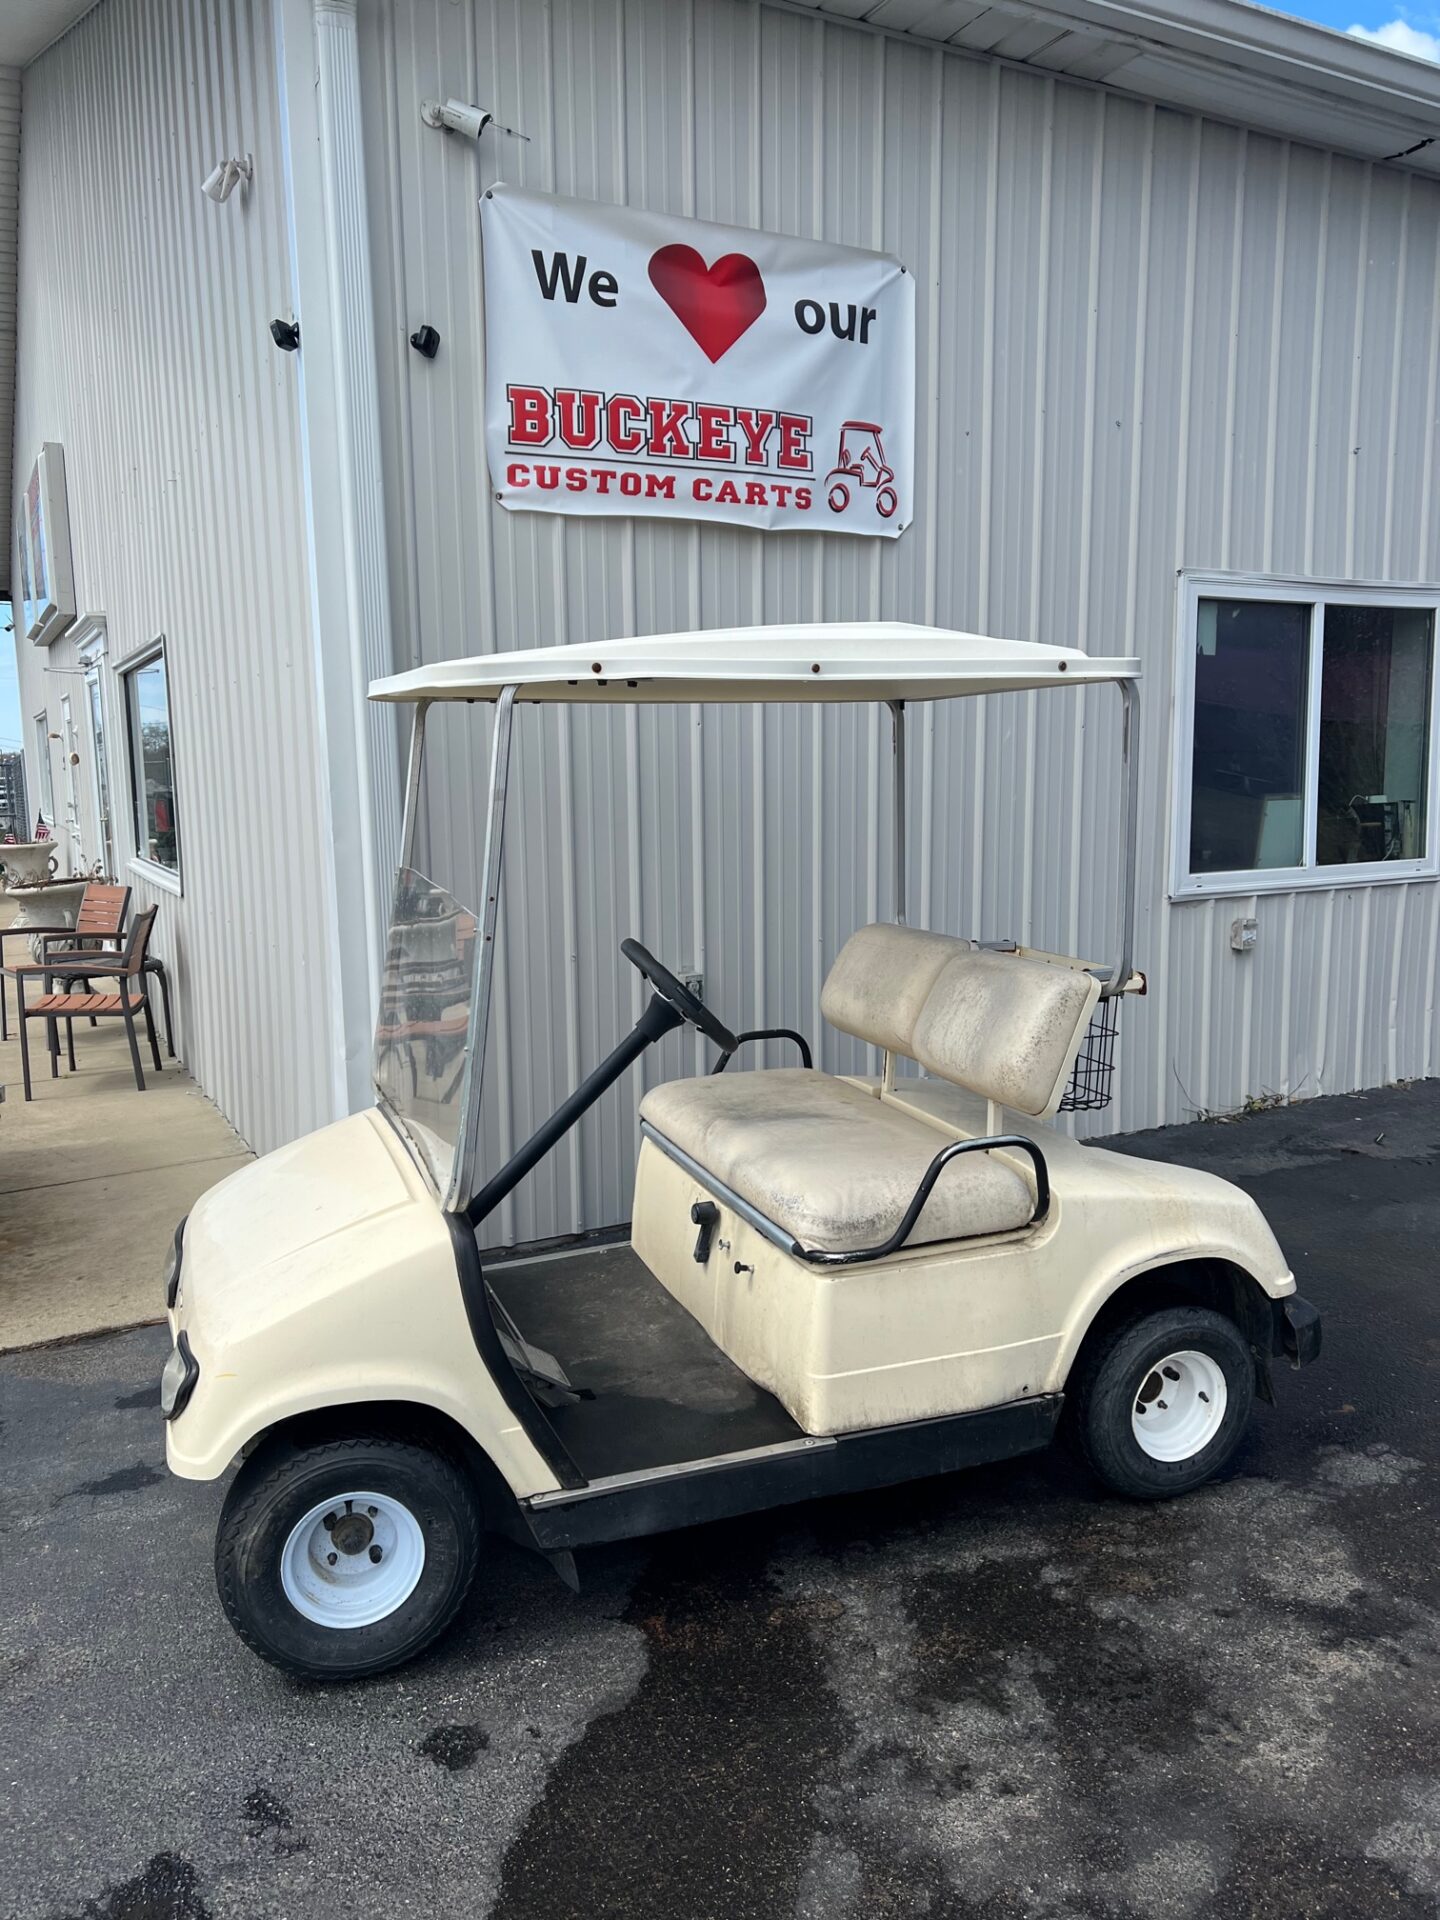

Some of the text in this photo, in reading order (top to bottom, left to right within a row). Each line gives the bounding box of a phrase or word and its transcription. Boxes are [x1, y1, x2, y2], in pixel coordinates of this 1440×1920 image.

[531, 249, 876, 344] We our
[506, 383, 813, 472] BUCKEYE
[507, 463, 812, 510] CUSTOM CARTS
